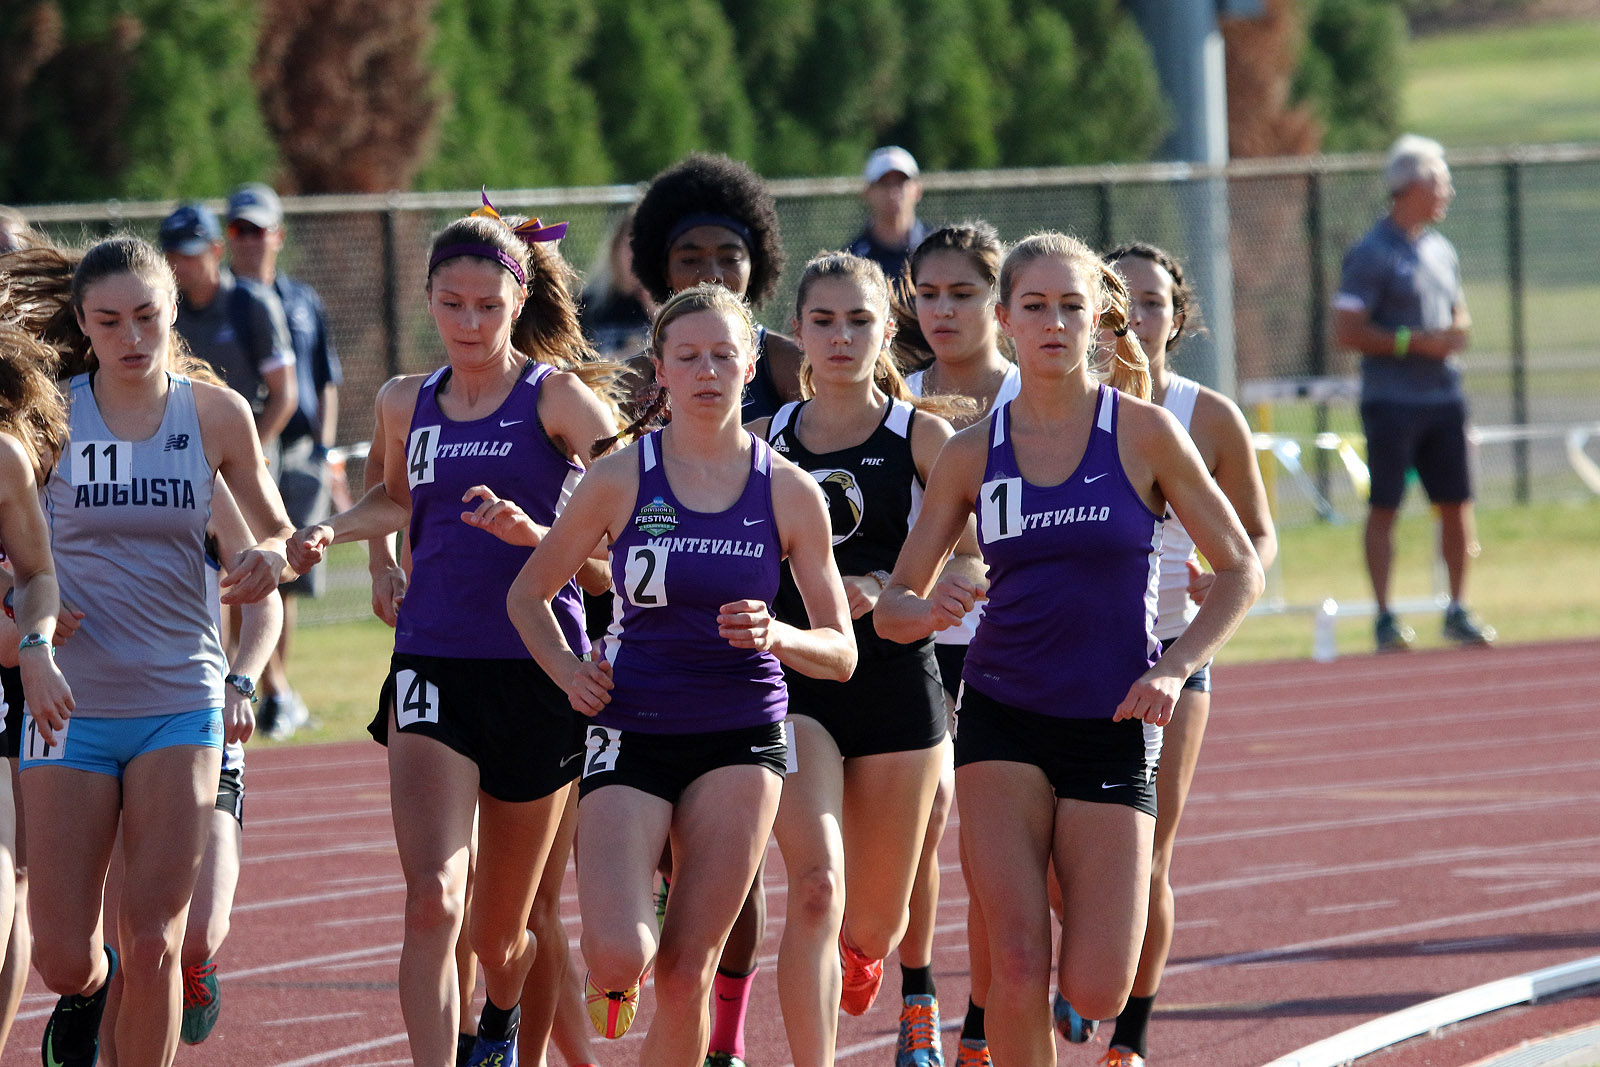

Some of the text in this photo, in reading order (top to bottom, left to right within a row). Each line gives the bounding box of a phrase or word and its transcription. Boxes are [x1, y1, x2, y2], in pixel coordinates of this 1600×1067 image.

[81, 443, 117, 482] 11
[410, 430, 430, 481] 4
[434, 441, 513, 458] TEVALLO
[74, 477, 196, 509] AUGUSTA
[990, 482, 1008, 536] 1
[634, 515, 679, 525] FESTIVAL
[1020, 506, 1110, 531] NTEVALLO
[633, 548, 658, 604] 2
[402, 672, 431, 718] 4
[587, 727, 611, 774] 2
